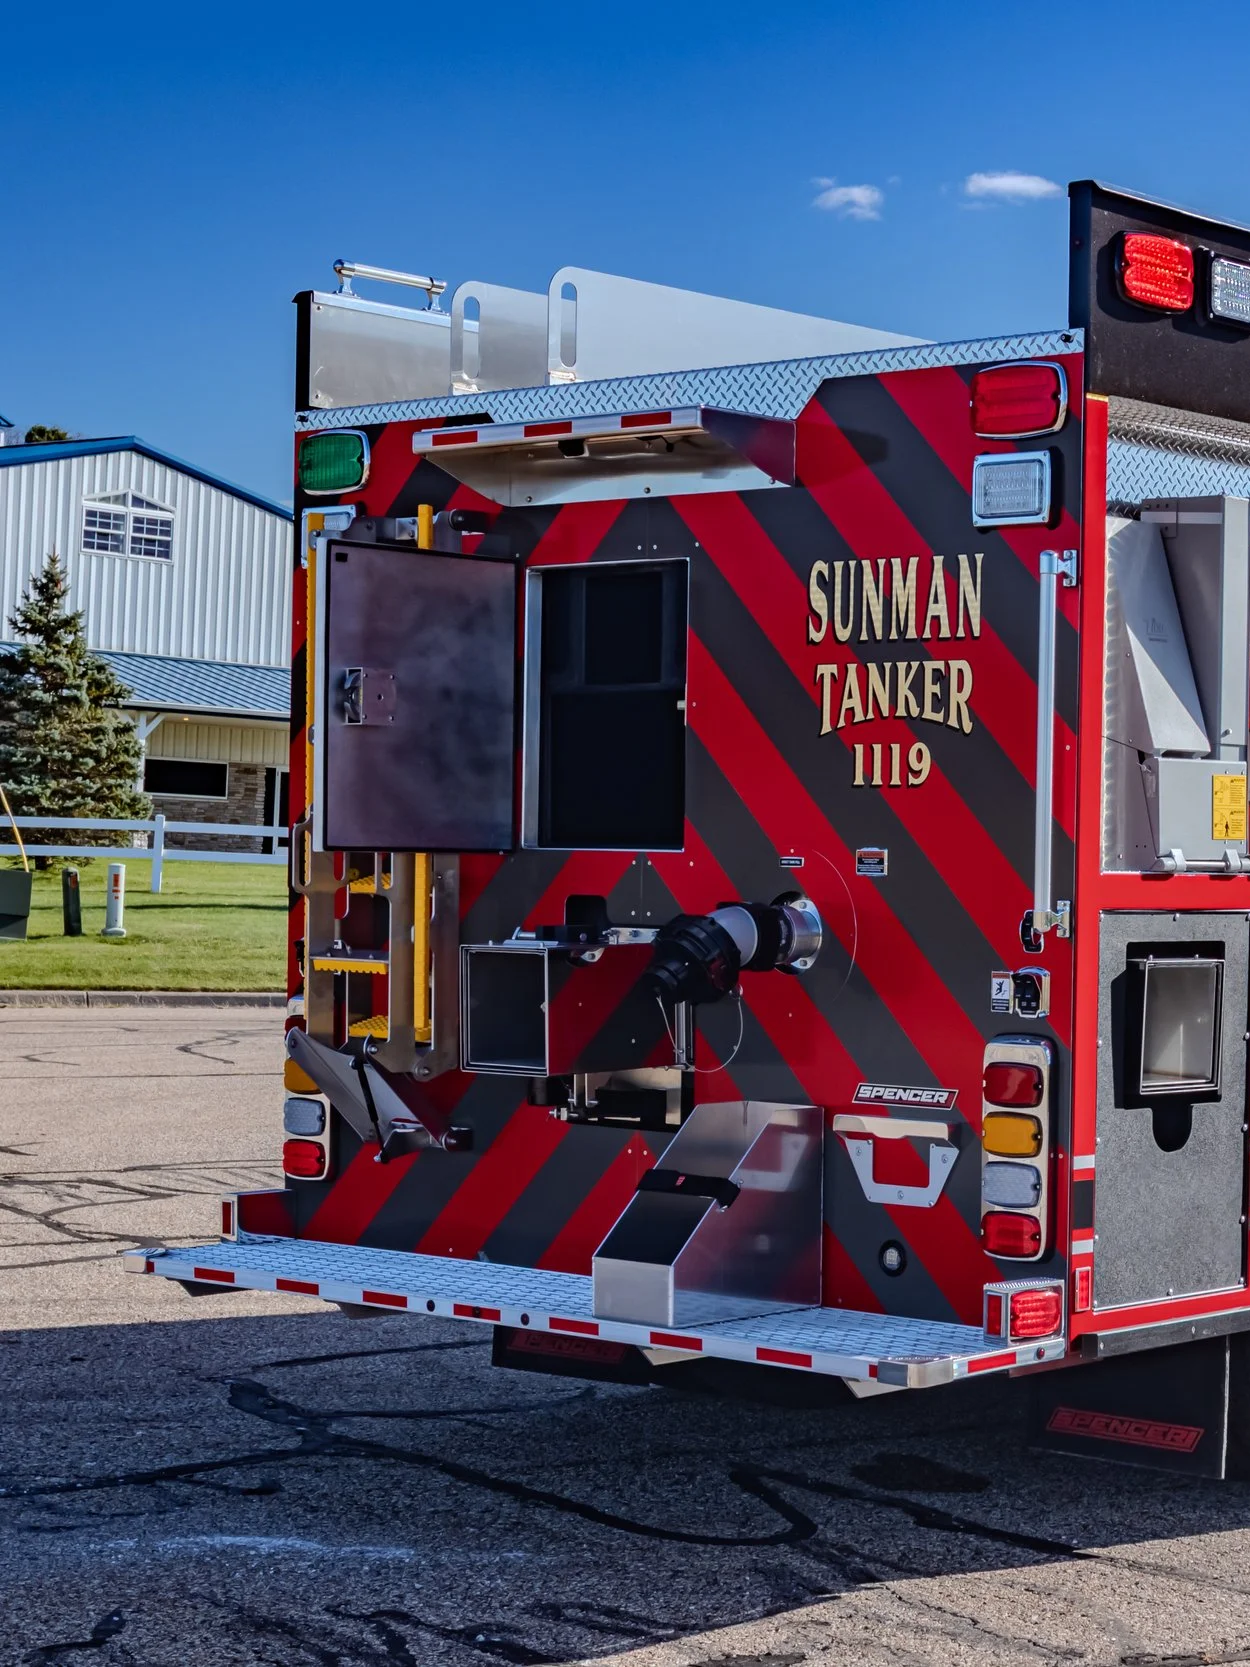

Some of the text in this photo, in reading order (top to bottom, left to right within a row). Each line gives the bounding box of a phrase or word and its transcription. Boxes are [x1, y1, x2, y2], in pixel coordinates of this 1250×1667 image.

[808, 553, 985, 643] SUNMAN
[815, 659, 973, 736] TANKER
[853, 741, 932, 786] 1119
[857, 1085, 949, 1105] SPENCER
[1051, 1410, 1191, 1444] SPENCER
